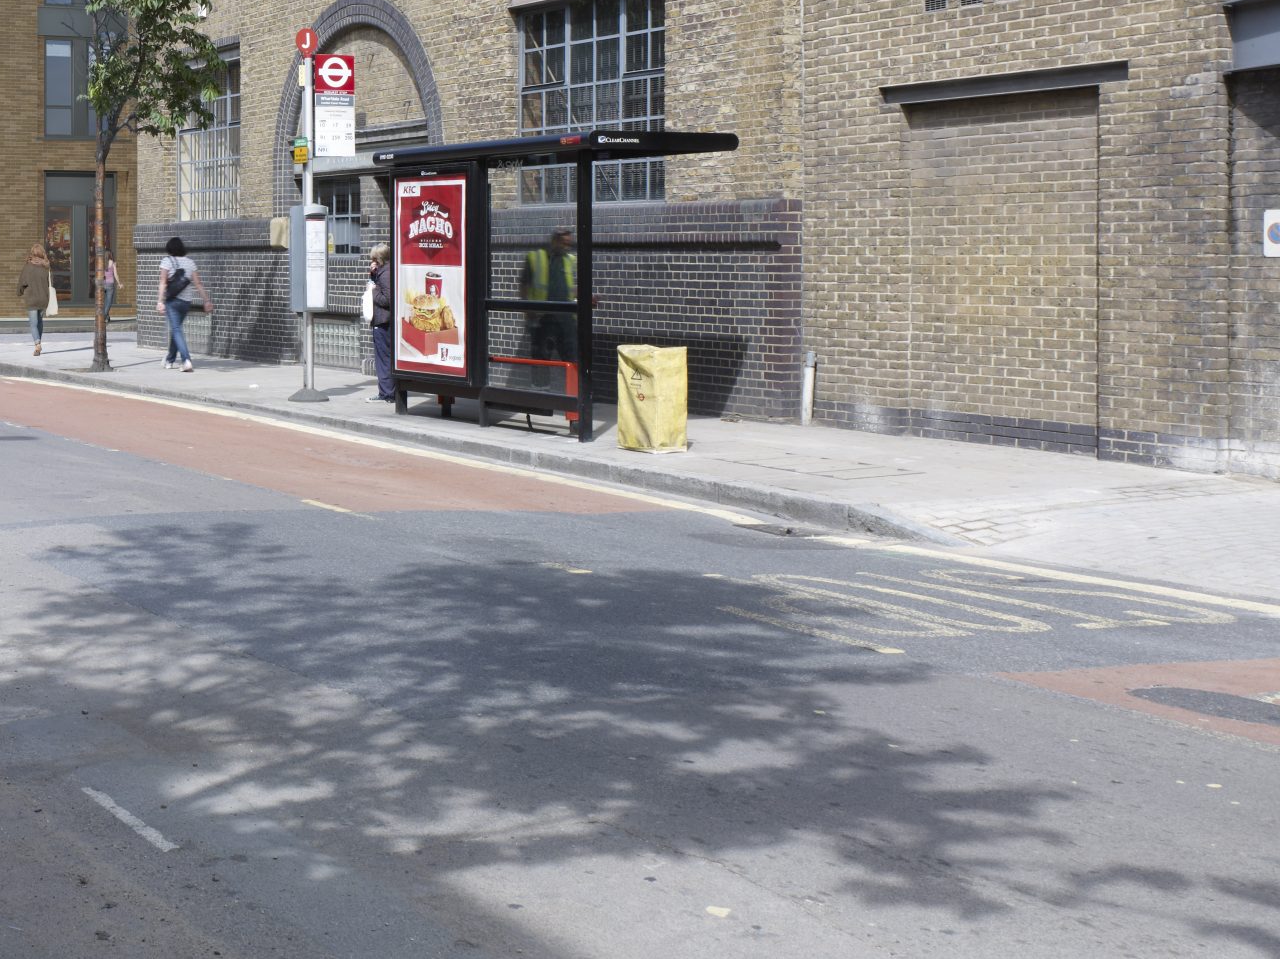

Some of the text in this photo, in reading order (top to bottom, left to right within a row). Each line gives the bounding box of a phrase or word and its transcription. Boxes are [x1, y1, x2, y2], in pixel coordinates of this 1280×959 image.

[301, 32, 310, 49] J
[403, 185, 416, 194] KFC
[408, 216, 454, 239] NACHO
